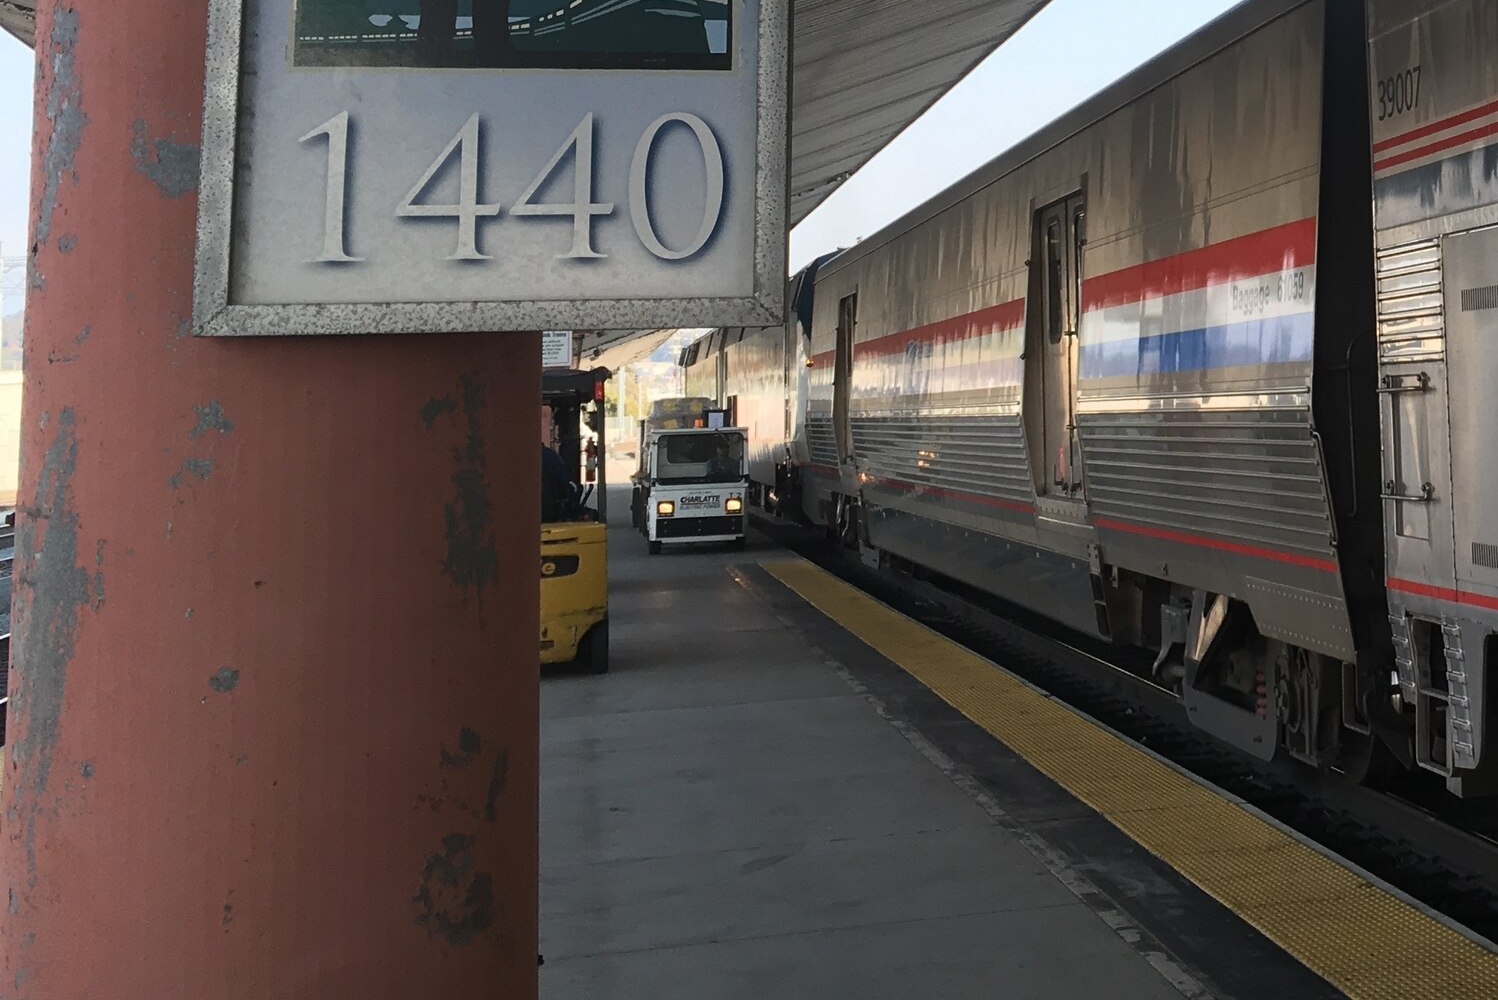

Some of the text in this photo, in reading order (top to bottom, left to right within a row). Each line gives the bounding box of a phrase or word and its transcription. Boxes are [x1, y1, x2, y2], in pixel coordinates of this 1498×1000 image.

[1377, 65, 1421, 121] 39007
[297, 109, 726, 264] 1440
[1232, 271, 1304, 314] Baggage 61059
[680, 495, 720, 503] CHARLATTE
